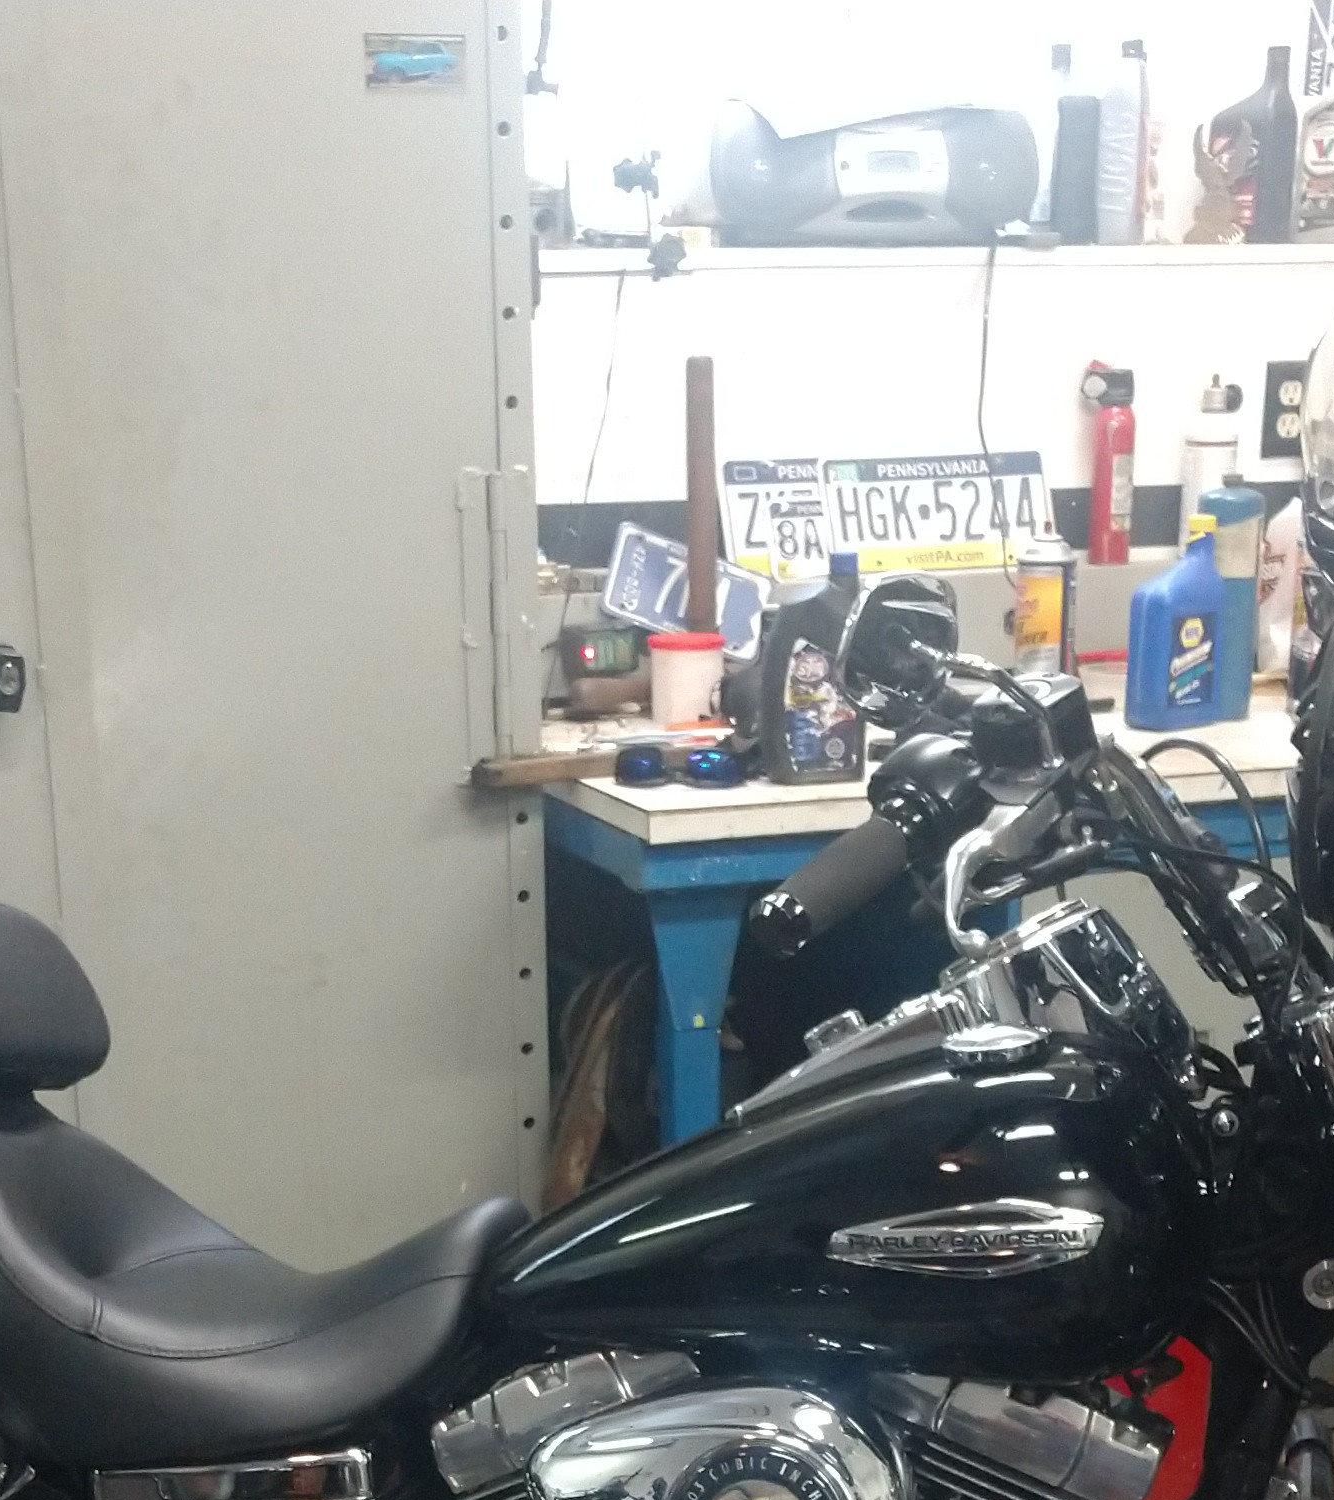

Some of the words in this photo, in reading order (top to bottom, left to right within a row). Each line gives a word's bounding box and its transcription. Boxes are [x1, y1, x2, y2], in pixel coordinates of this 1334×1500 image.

[876, 459, 990, 479] PENNSYLVANIA
[905, 550, 985, 565] visitPA.com
[847, 1229, 1081, 1251] HARLEY-DAVIDSON
[708, 1456, 767, 1482] CUBIC
